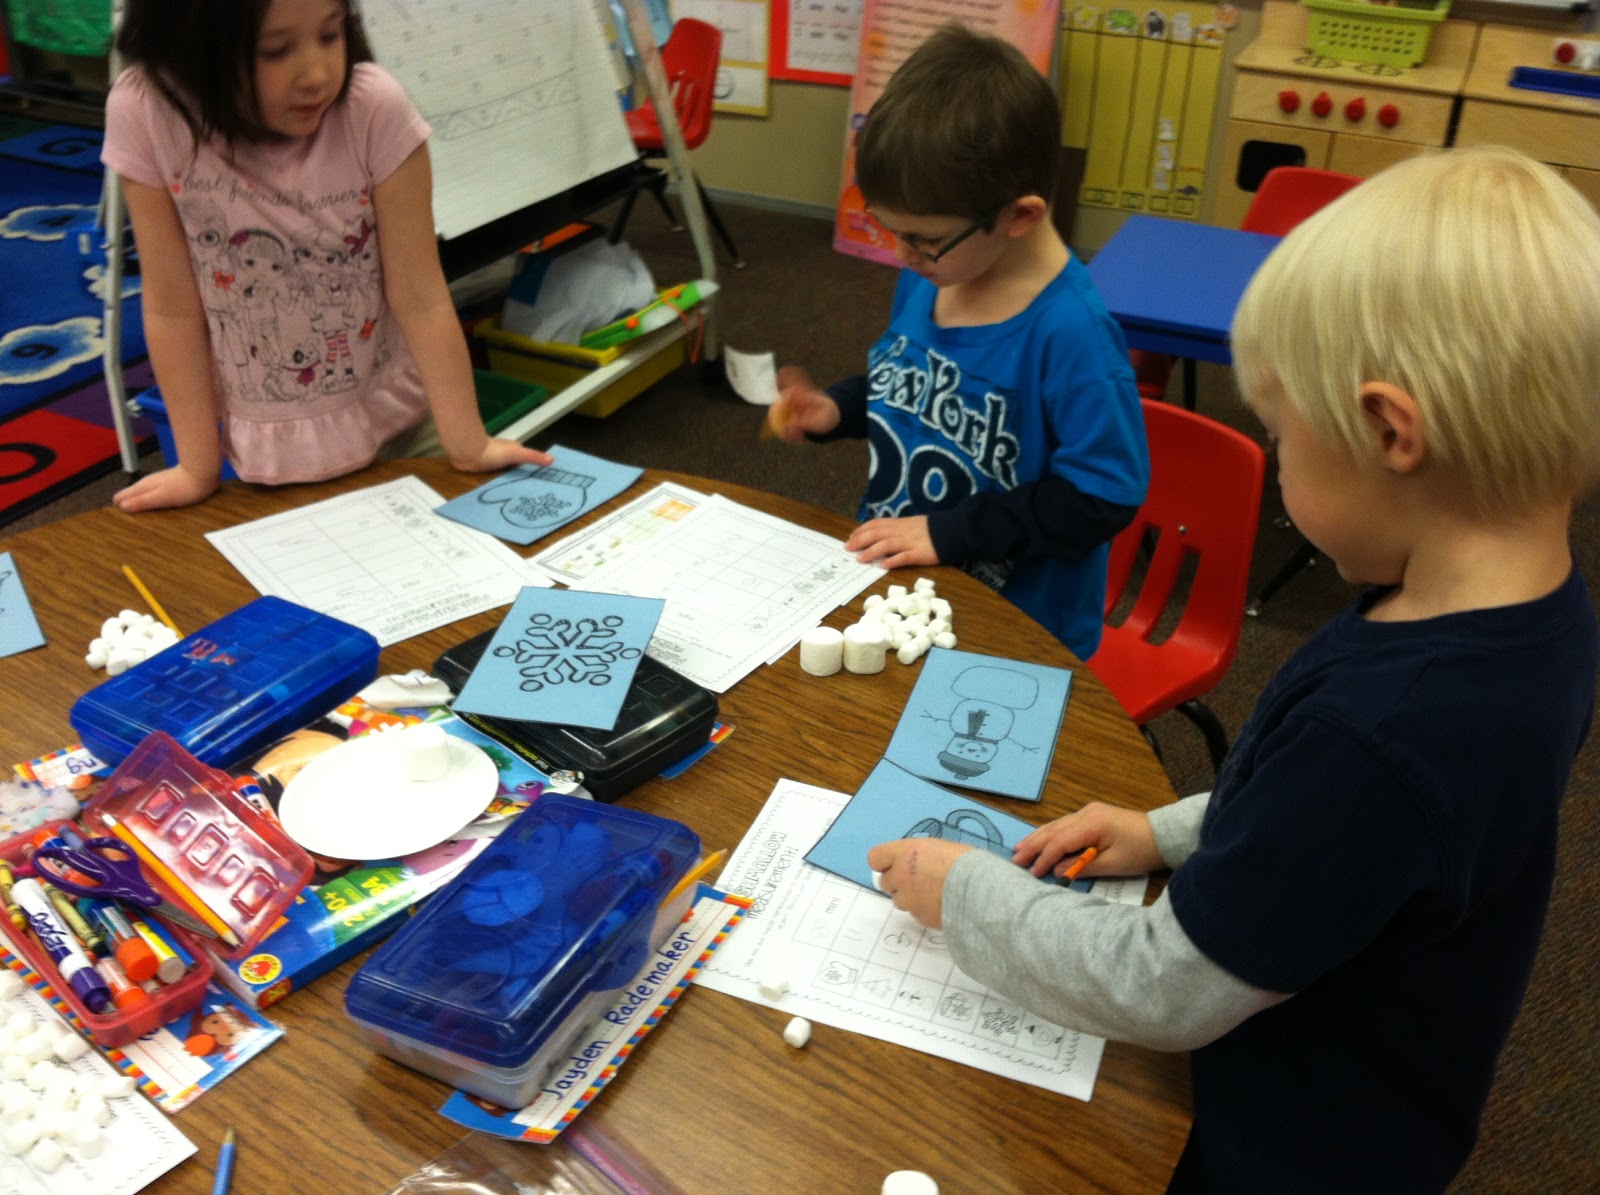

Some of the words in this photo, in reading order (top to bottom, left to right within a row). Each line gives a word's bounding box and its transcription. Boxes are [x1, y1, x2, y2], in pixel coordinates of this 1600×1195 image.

[919, 349, 1020, 491] York
[735, 831, 787, 898] SHMALLOW
[541, 1040, 611, 1100] Jayden
[603, 931, 696, 1026] Rademaker
